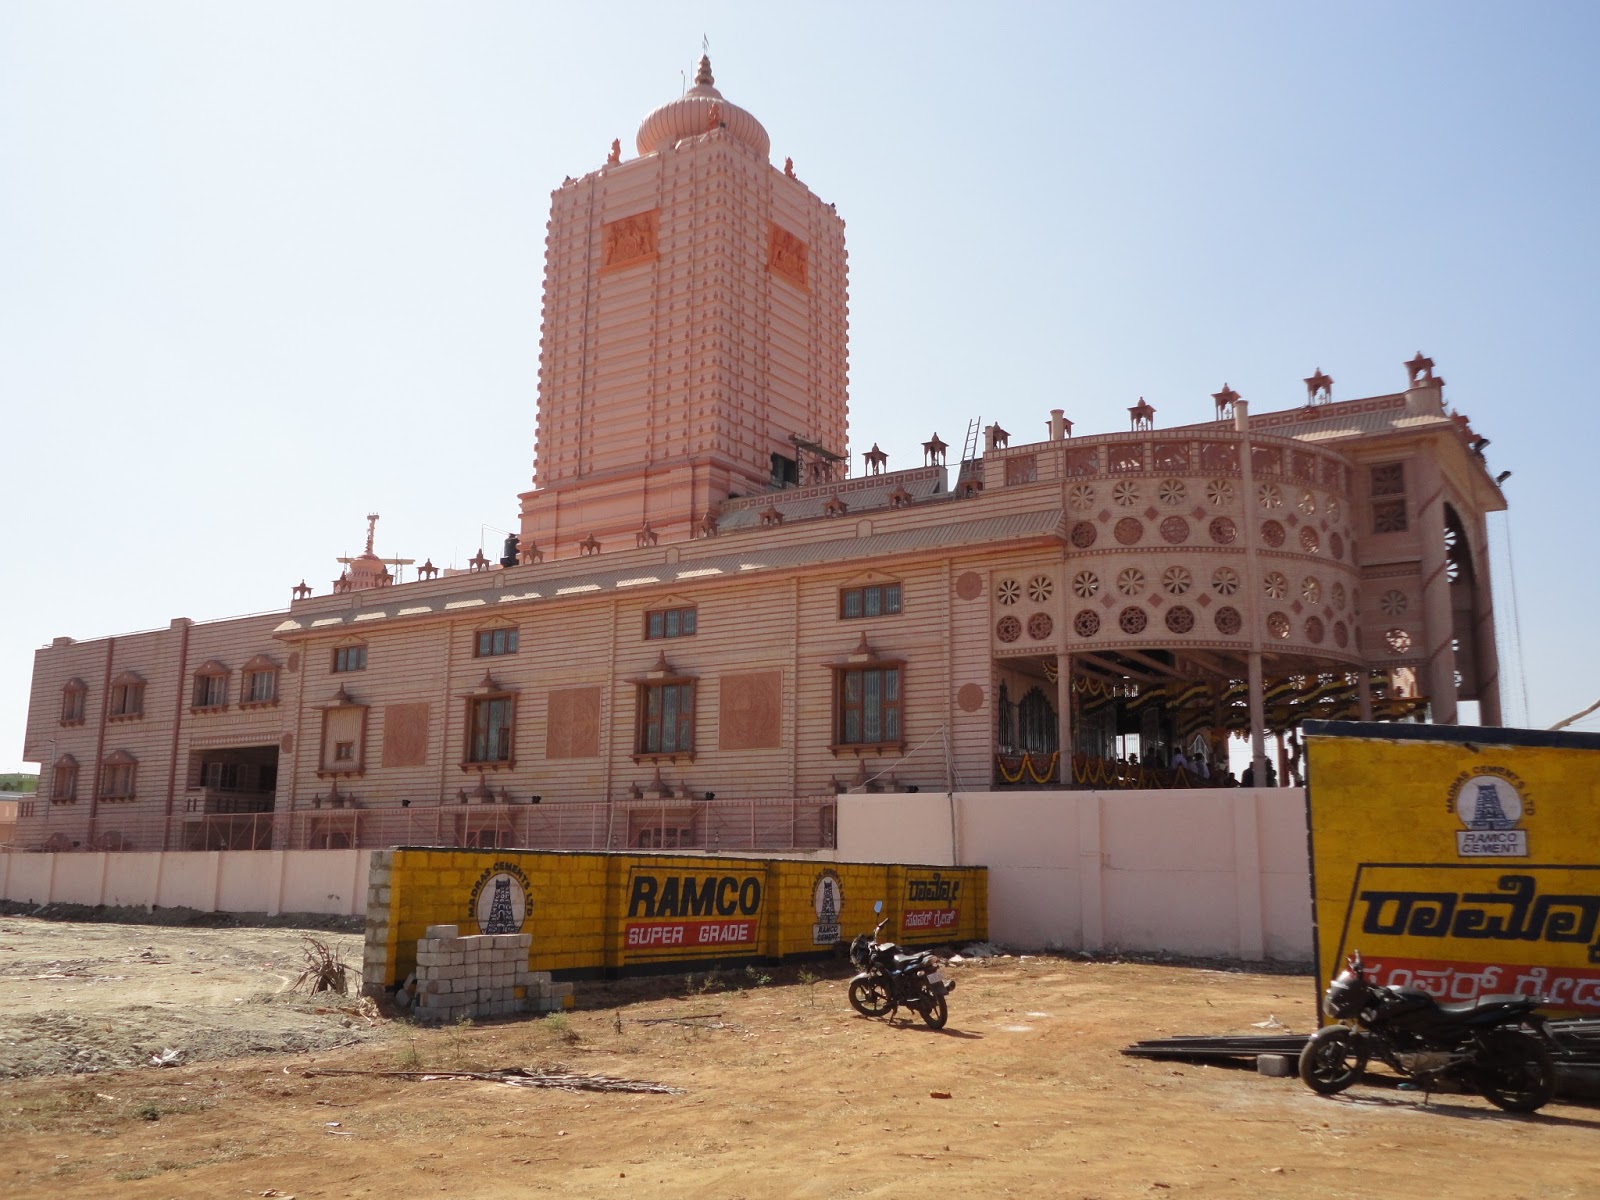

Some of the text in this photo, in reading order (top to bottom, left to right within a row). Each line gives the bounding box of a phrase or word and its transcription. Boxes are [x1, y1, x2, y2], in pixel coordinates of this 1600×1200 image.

[1446, 766, 1535, 816] MADRAS CEMENTS LTD
[1462, 844, 1518, 853] CEMENT
[1464, 833, 1517, 843] RAMCO
[468, 862, 534, 918] MADRAS CEMENTS LTD
[628, 876, 761, 917] RAMCO
[629, 924, 748, 945] SUPER GRADE
[817, 933, 839, 942] CEMENT
